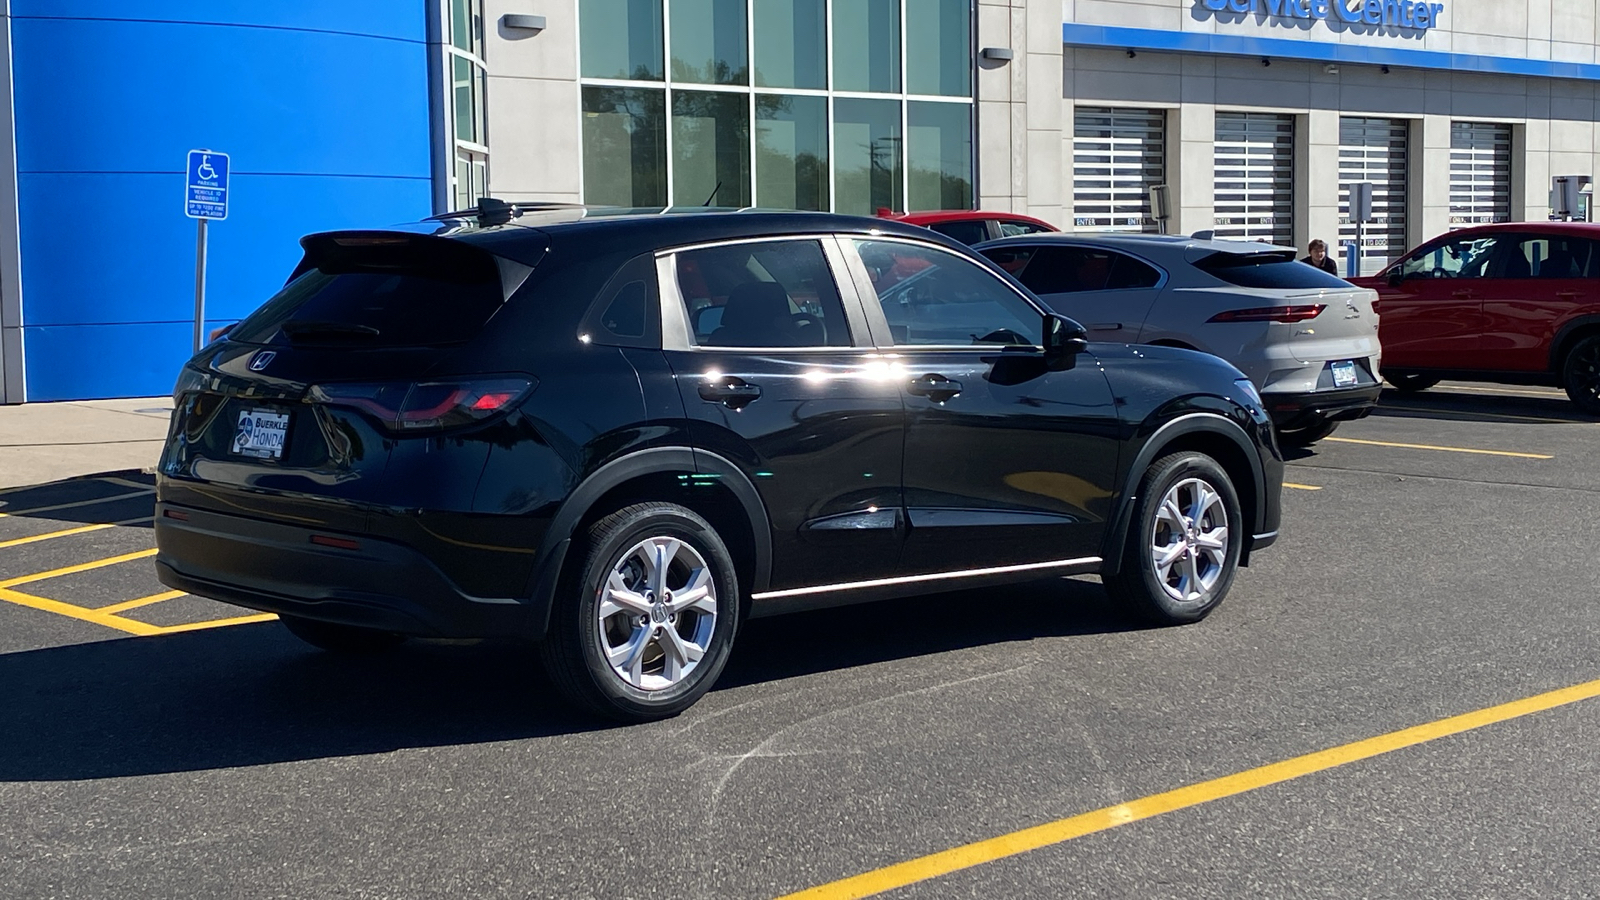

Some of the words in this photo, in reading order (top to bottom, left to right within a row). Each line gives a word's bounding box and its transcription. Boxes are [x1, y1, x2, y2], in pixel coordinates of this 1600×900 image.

[1335, 0, 1444, 28] Center
[1076, 218, 1096, 226] ENTER
[1127, 218, 1147, 226] ENTER
[256, 418, 288, 430] BUERKLE
[252, 429, 283, 447] HONDA
